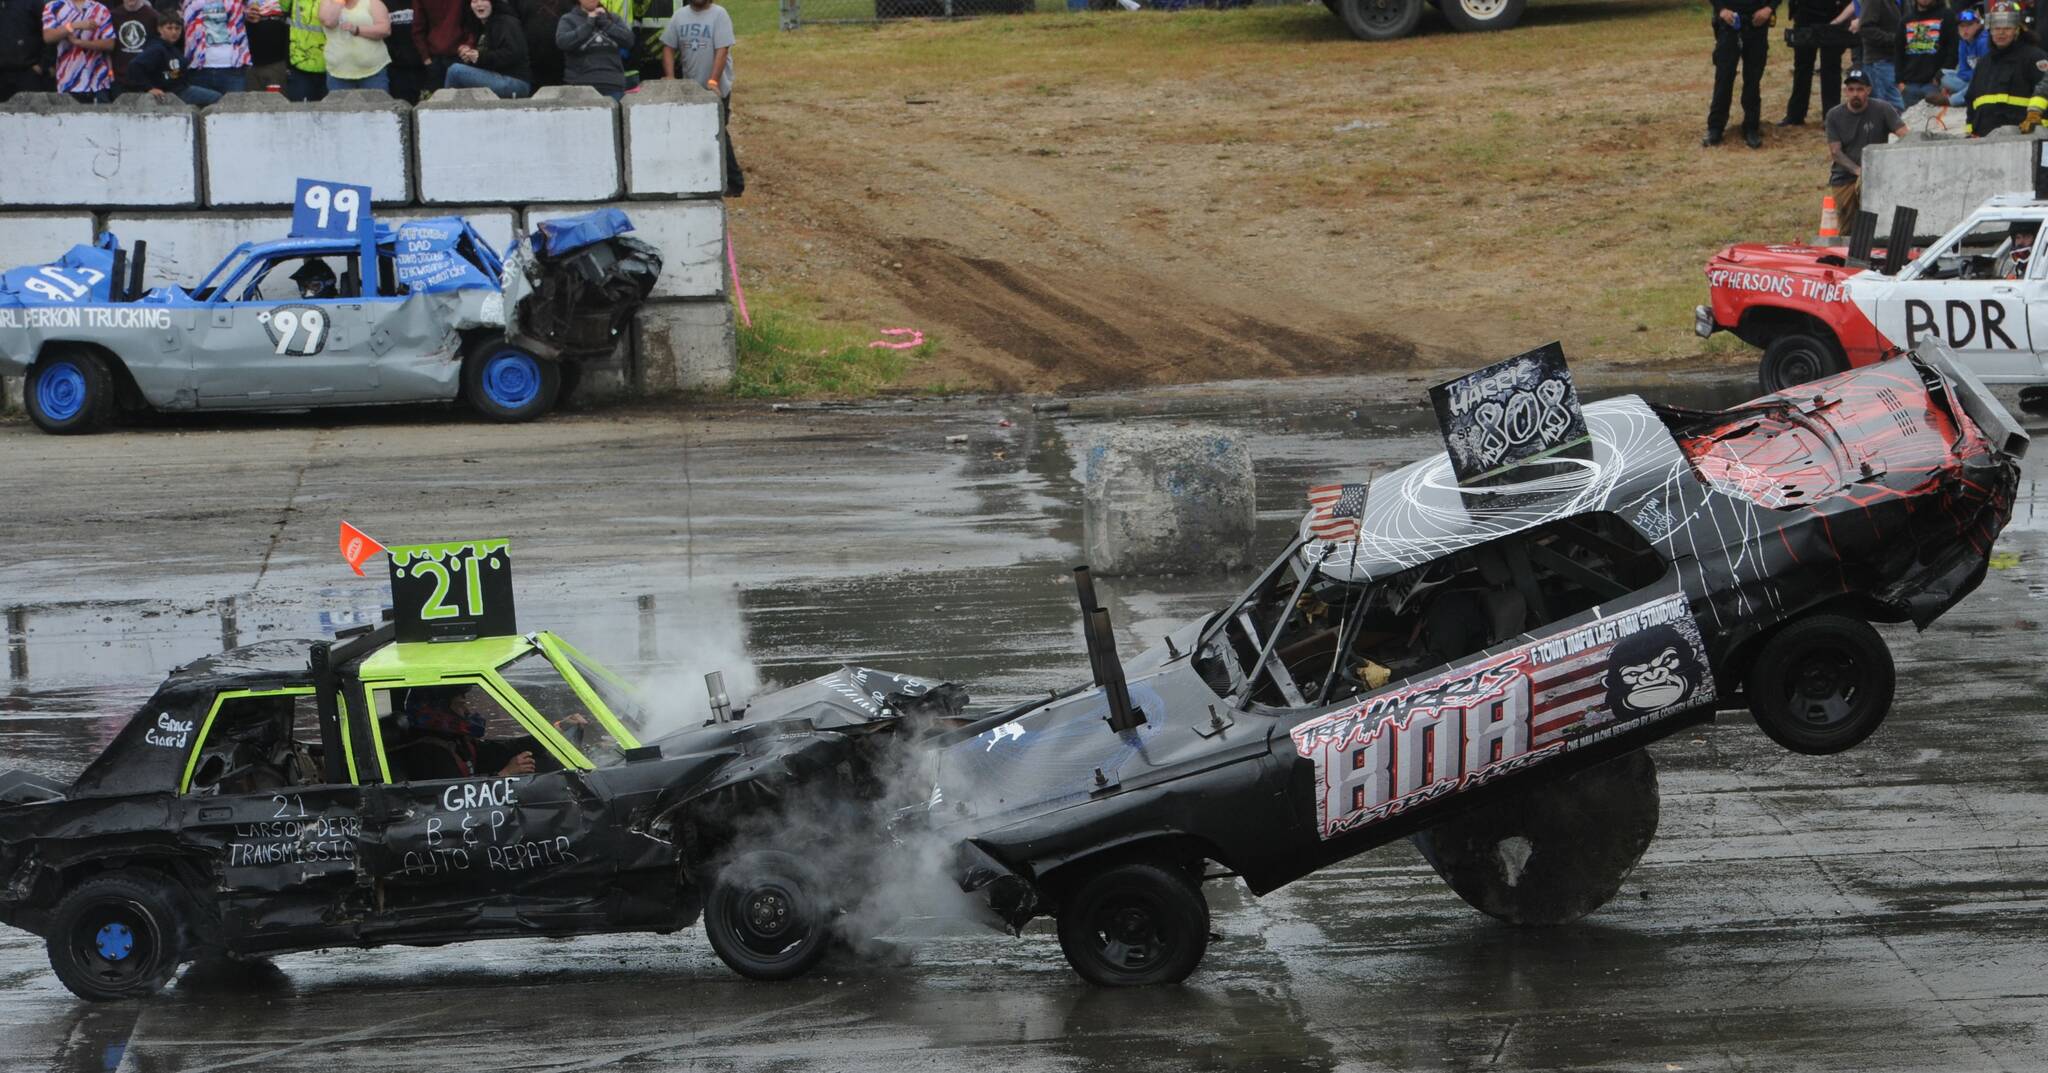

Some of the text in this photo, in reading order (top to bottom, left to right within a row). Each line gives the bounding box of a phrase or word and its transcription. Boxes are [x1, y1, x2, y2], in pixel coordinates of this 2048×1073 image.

[680, 23, 712, 39] USA
[305, 185, 359, 232] 99
[408, 240, 431, 251] DAD
[1708, 270, 1851, 303] CPHERSON'S TIMBER
[84, 307, 171, 329] TRUCKING
[274, 309, 324, 355] 99
[1905, 299, 2018, 350] BDR
[1450, 360, 1535, 416] HARRIS
[1457, 379, 1571, 467] SP 808
[1632, 497, 1660, 526] LAYTON
[411, 556, 483, 620] 21
[1566, 627, 1596, 655] MAFIA
[1595, 620, 1618, 643] LAST
[1617, 613, 1640, 637] MAN
[1639, 598, 1685, 631] STANDING
[1327, 674, 1531, 826] 808
[272, 793, 308, 818] 21
[444, 777, 521, 811] GRACE
[235, 820, 305, 838] LARSON
[427, 817, 443, 846] B
[491, 810, 505, 841] P
[1329, 798, 1398, 836] WEST
[403, 836, 580, 876] AUTO REPAIR
